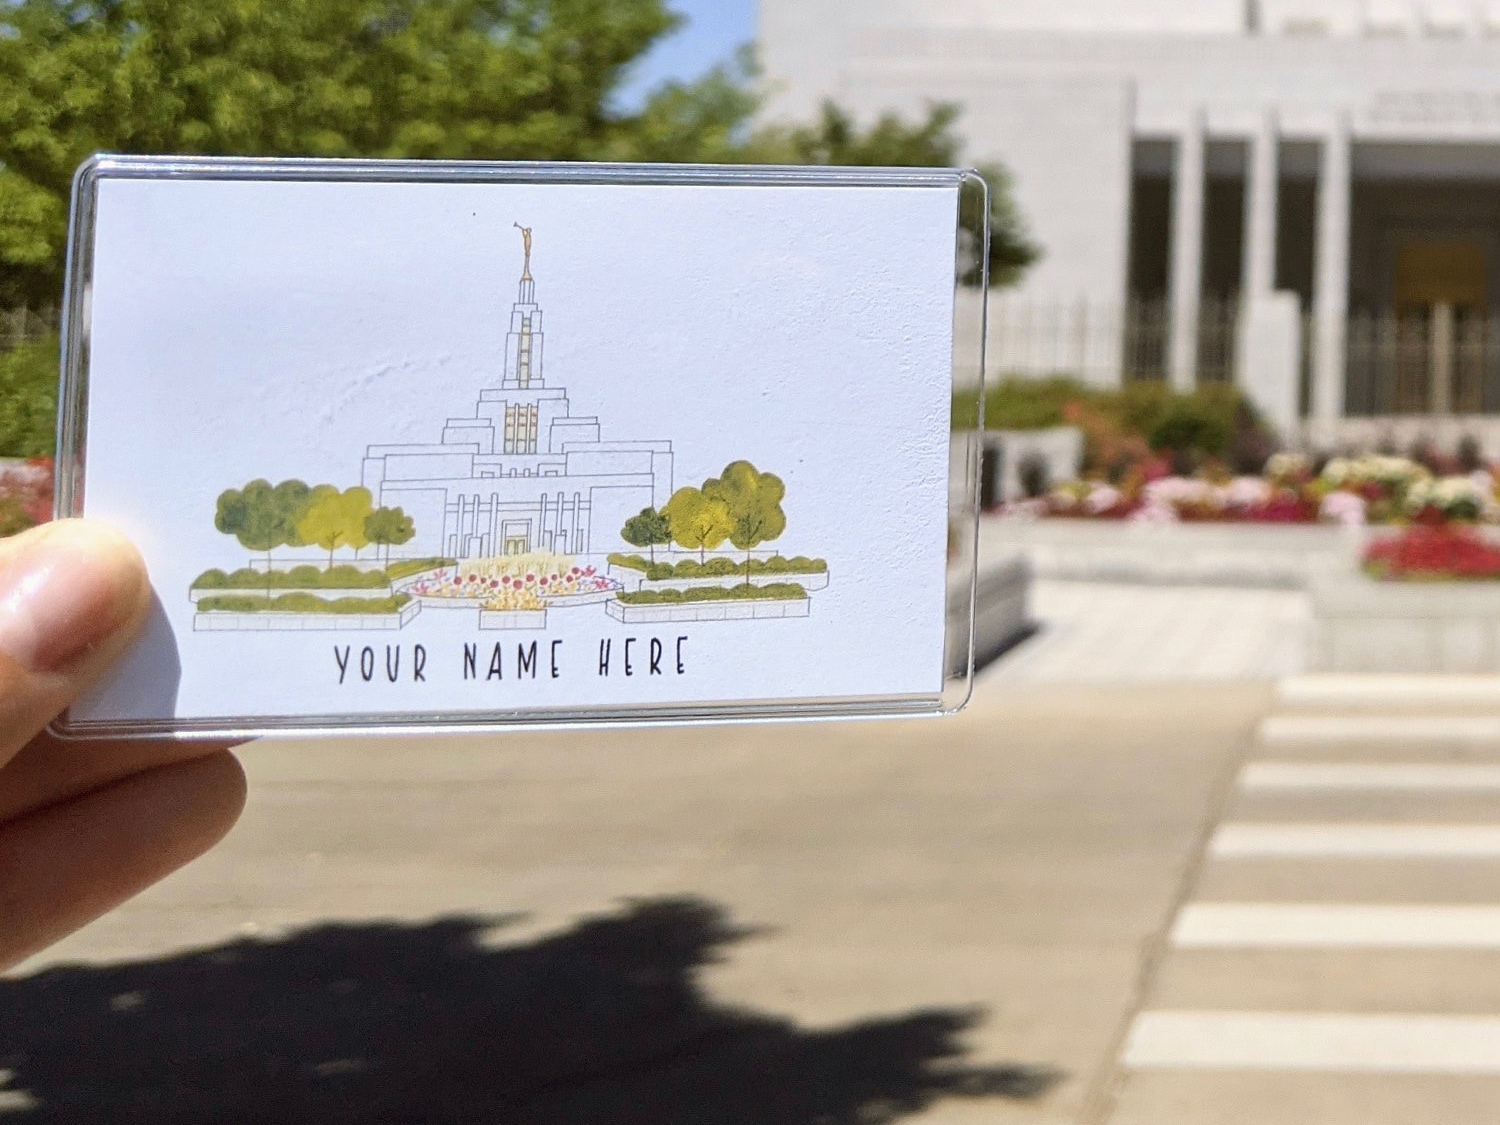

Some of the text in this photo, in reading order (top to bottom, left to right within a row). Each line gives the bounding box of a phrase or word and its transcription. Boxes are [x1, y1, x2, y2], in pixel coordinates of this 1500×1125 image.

[333, 635, 689, 684] YOUR NAME HERE
